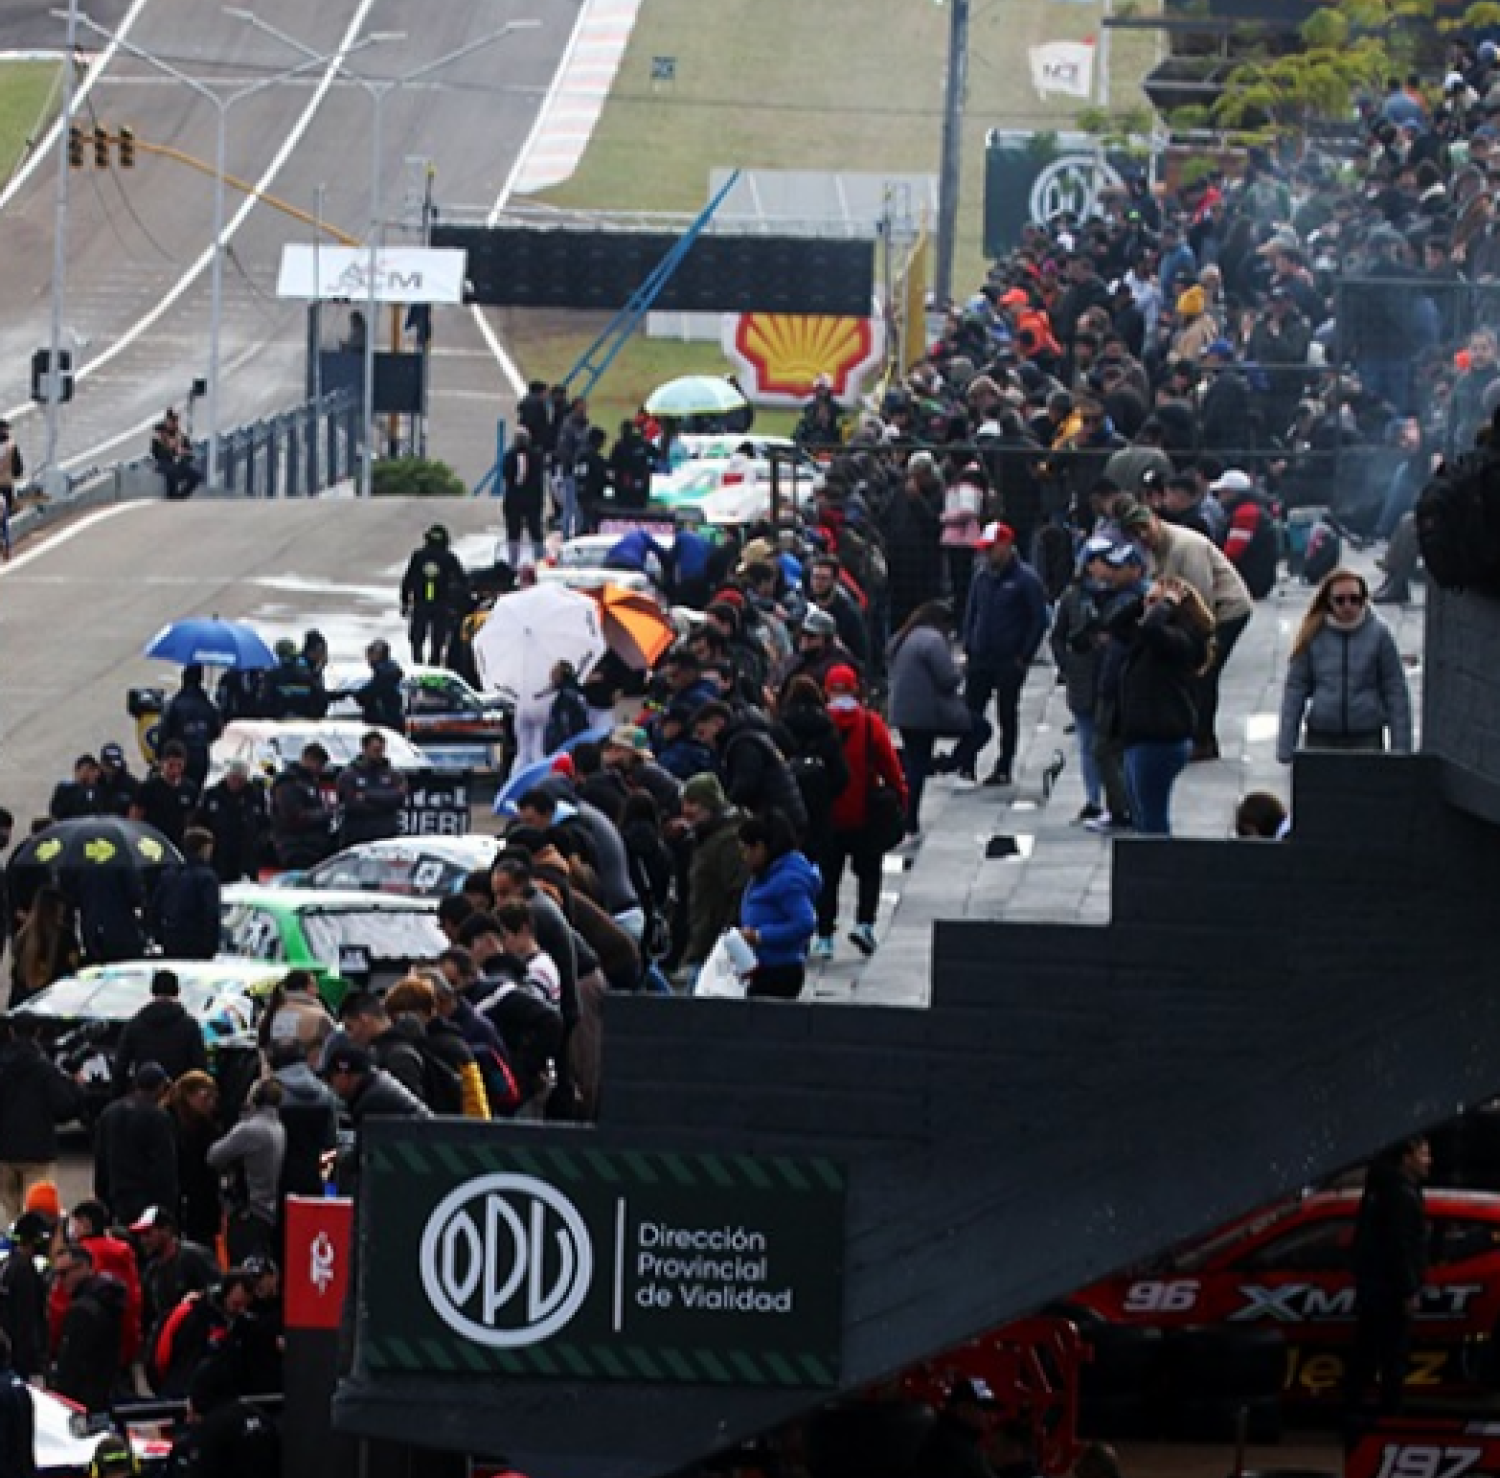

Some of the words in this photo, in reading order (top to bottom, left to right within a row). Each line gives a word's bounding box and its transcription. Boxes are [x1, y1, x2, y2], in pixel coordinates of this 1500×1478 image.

[638, 1222, 766, 1251] Dirección
[637, 1252, 768, 1282] Provincial
[635, 1284, 672, 1308] de
[679, 1284, 793, 1313] Vialidad
[1122, 1280, 1200, 1312] 96
